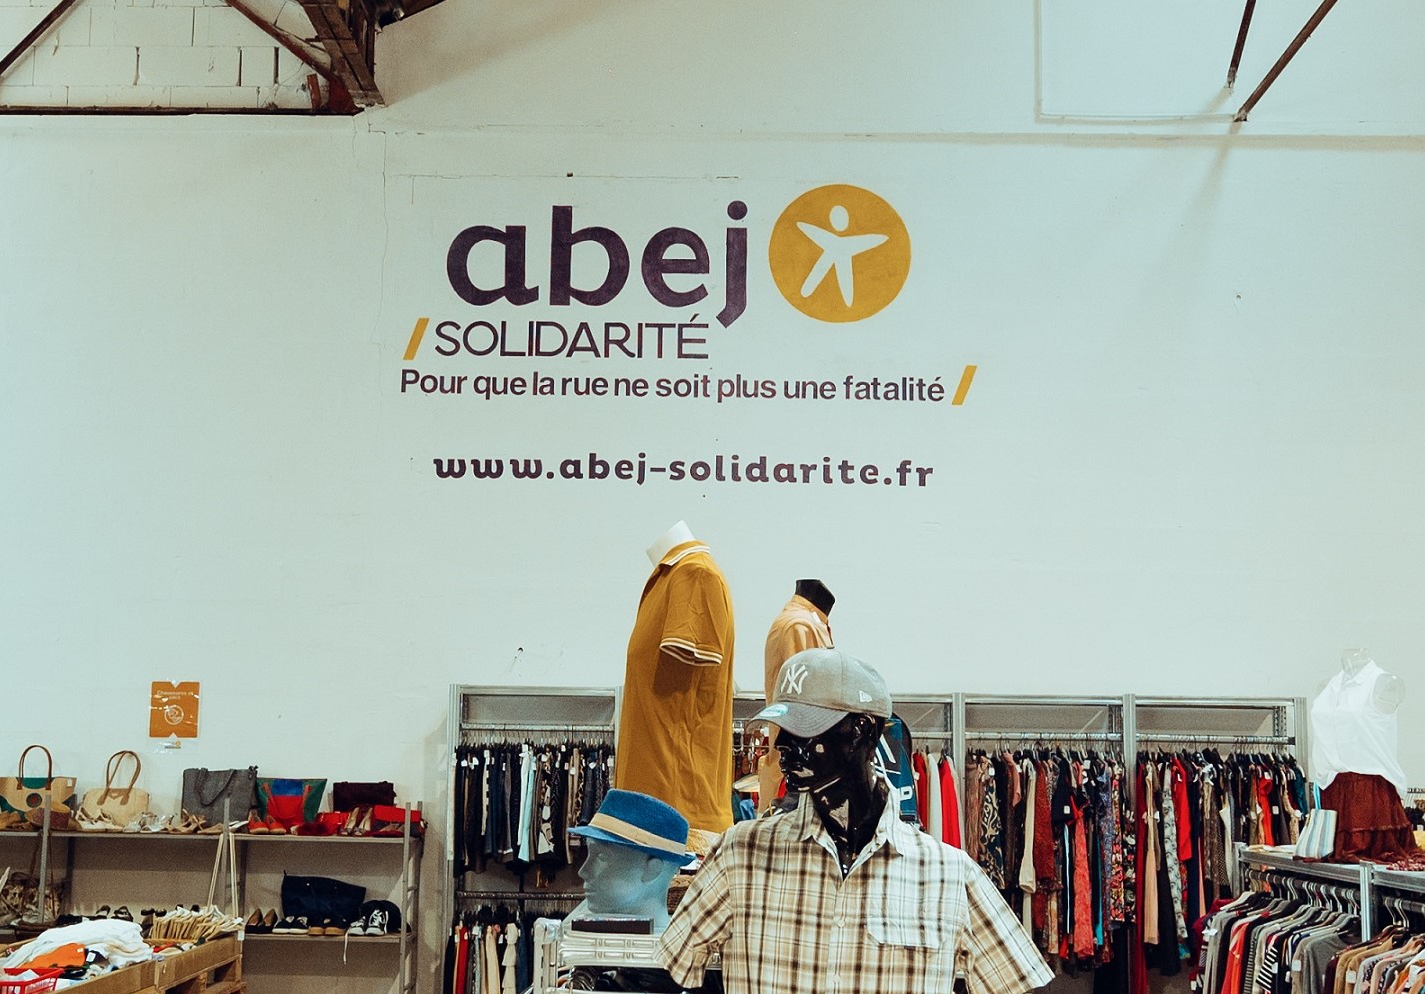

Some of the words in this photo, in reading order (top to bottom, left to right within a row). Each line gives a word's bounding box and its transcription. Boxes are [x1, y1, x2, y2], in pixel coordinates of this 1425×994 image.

[447, 201, 748, 328] abej
[401, 369, 467, 394] Pour
[474, 376, 526, 401] que
[532, 372, 555, 396] la
[561, 377, 608, 396] rue
[614, 378, 649, 398] ne
[655, 374, 711, 398] soit
[718, 374, 777, 404] plus
[784, 381, 837, 400] une
[843, 376, 945, 402] fatalité
[434, 453, 934, 487] www.abej-solidarite.fr
